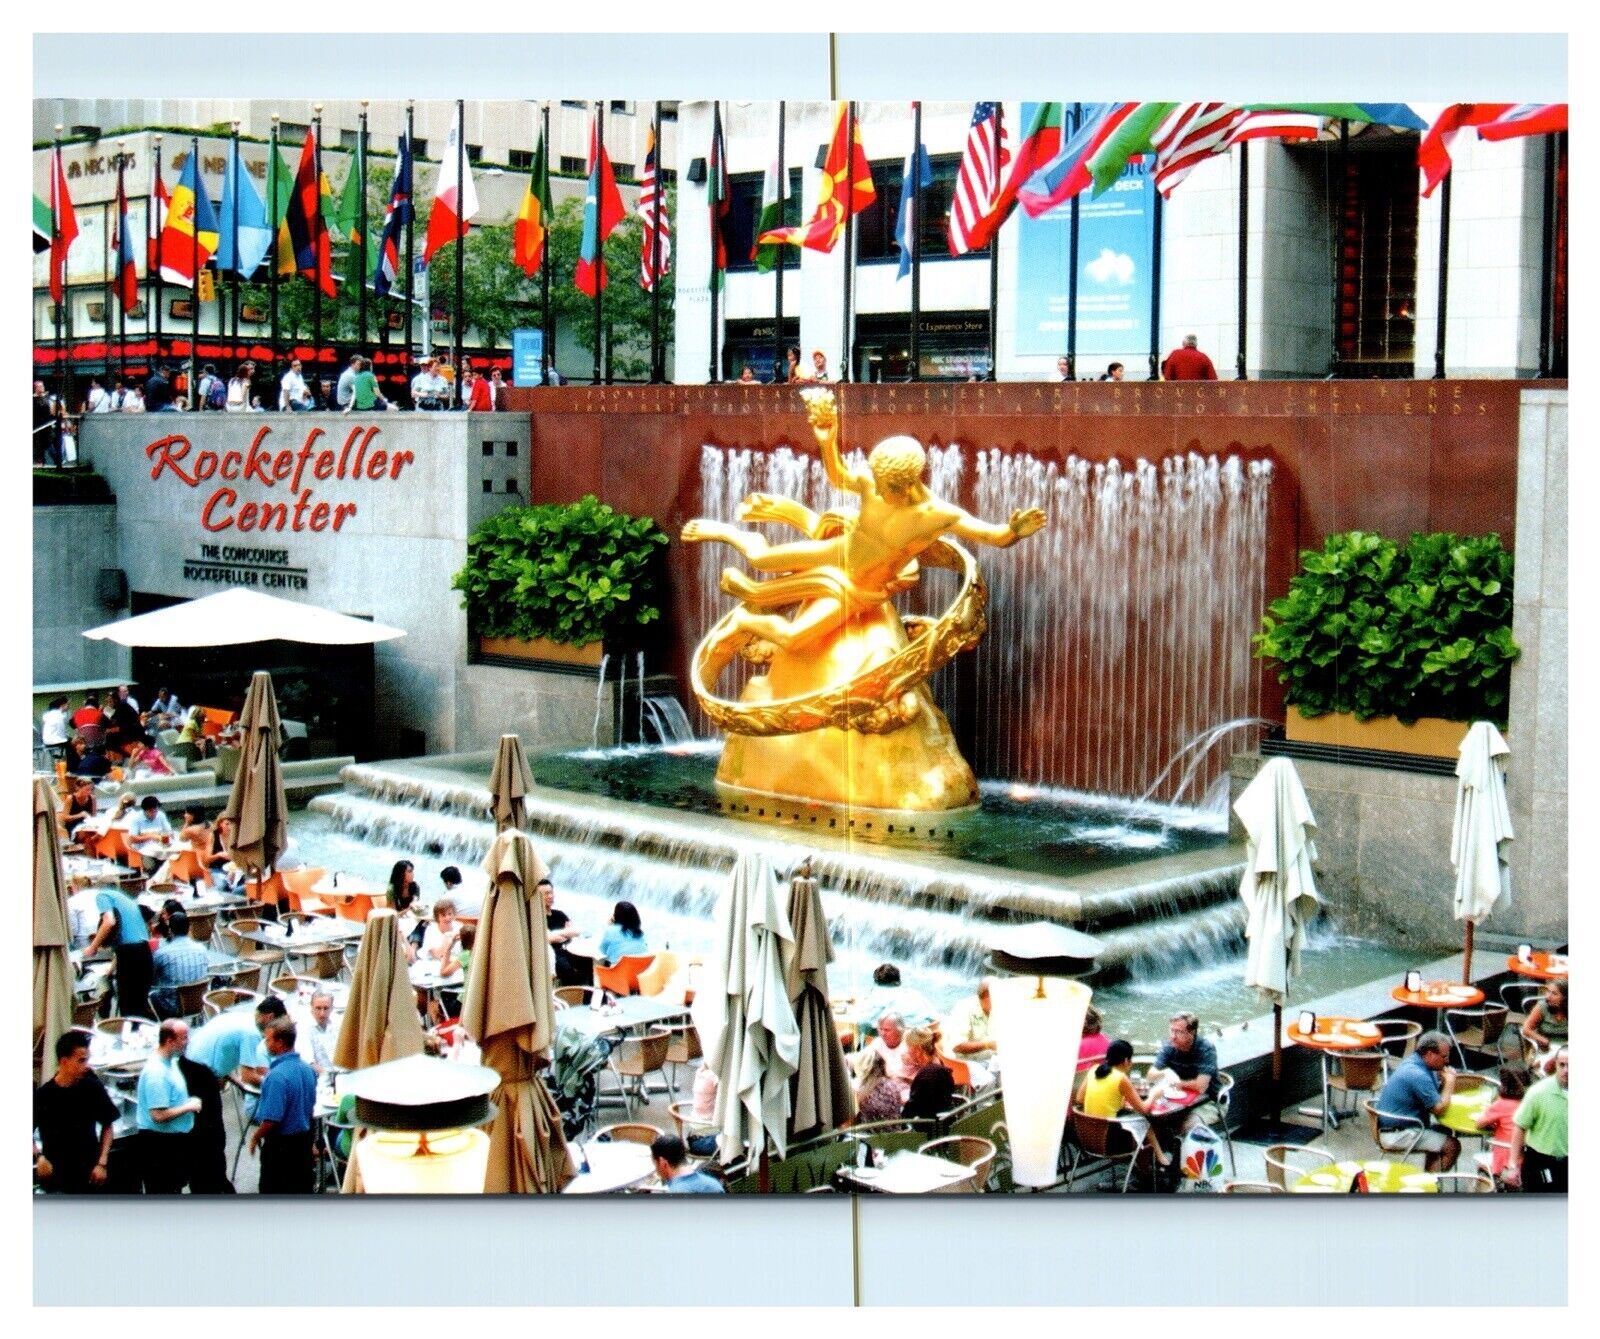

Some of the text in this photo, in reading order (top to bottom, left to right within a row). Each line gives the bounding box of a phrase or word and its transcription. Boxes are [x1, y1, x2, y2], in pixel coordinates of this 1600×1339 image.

[84, 156, 104, 175] NBC
[203, 156, 226, 175] NB
[1034, 387, 1080, 398] ART
[1378, 385, 1463, 399] FIRE
[1403, 402, 1488, 415] ENDS
[201, 544, 289, 566] THE CONCOURSE
[183, 565, 309, 591] ROCKEFELLER CENTER
